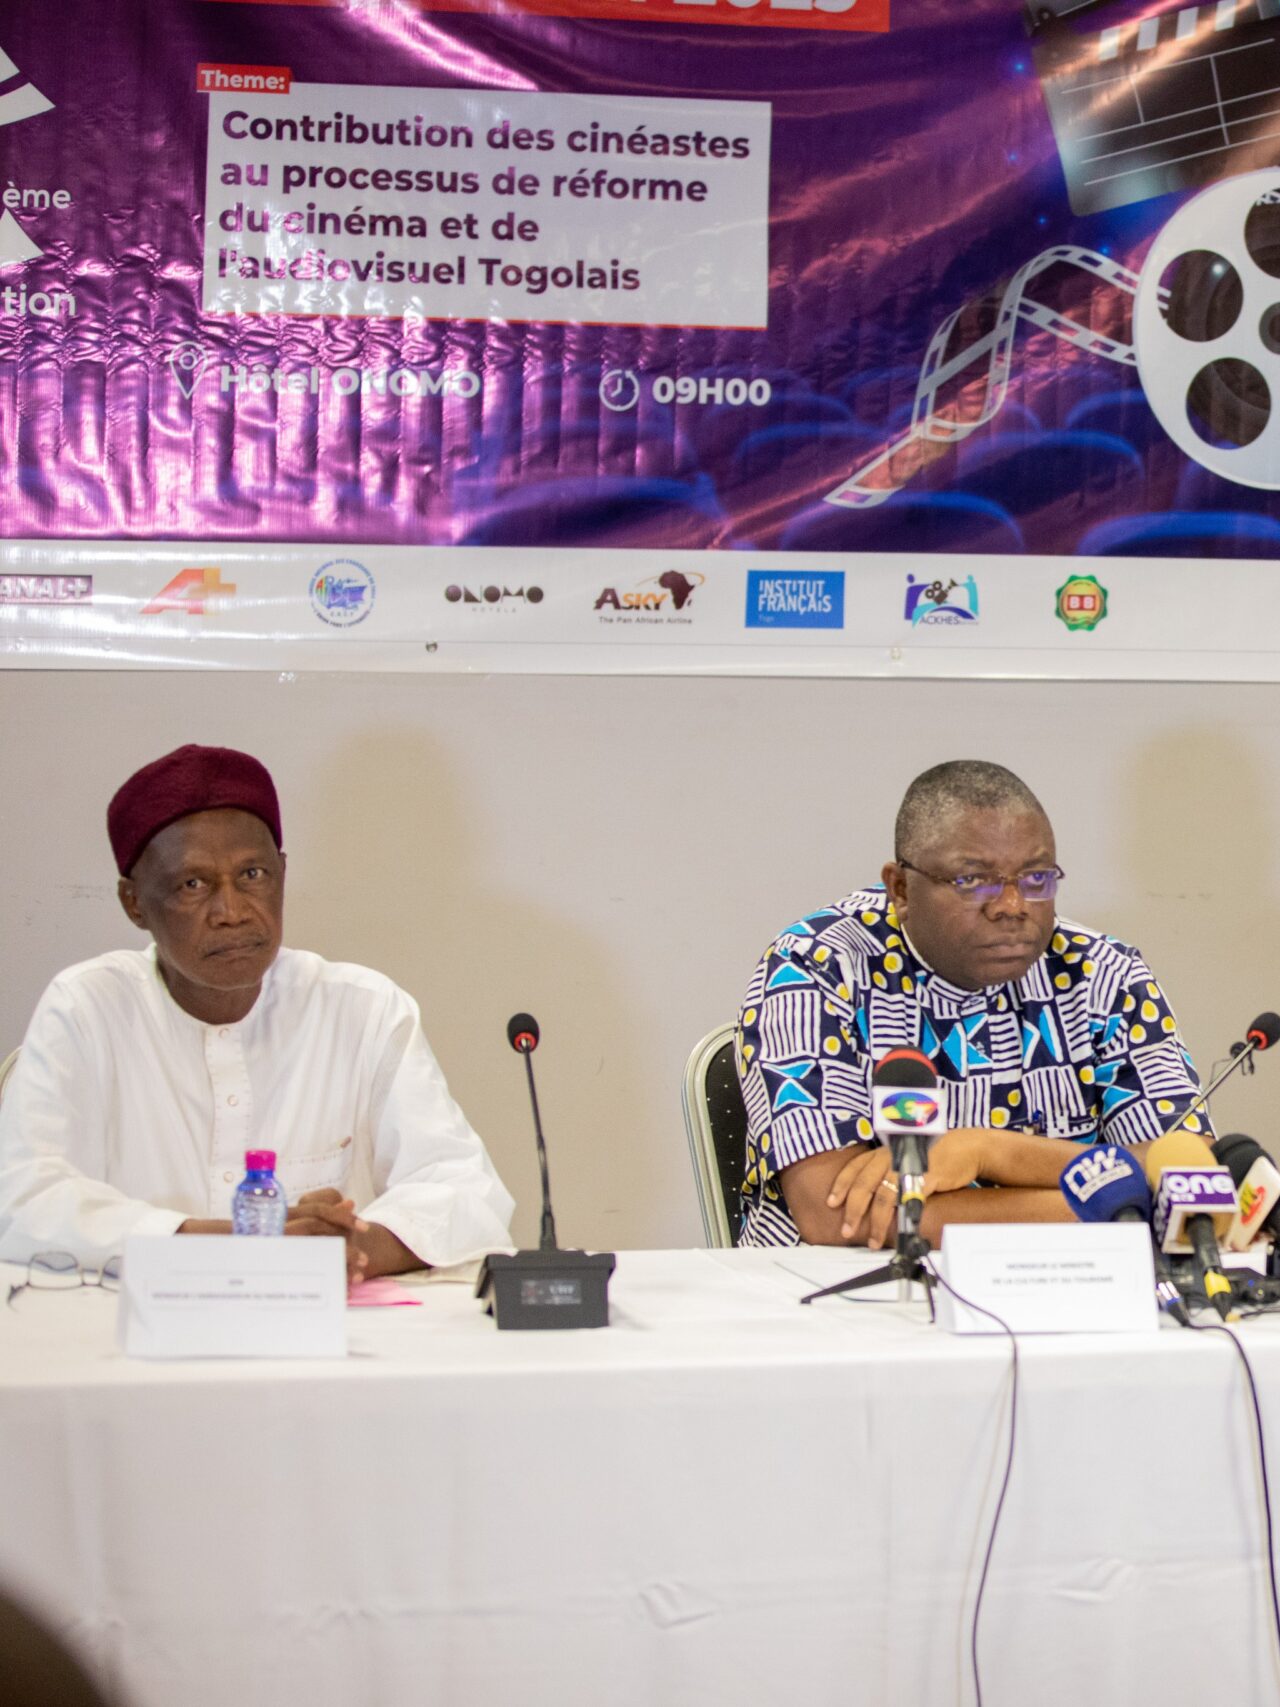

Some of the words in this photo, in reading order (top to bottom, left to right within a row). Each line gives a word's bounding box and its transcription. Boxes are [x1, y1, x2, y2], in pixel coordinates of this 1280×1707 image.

[200, 69, 285, 90] Theme:
[222, 110, 473, 148] Contribution
[486, 120, 554, 151] des
[566, 121, 750, 158] cinéastes
[220, 162, 269, 186] au
[282, 163, 480, 194] processus
[492, 166, 540, 196] de
[552, 168, 708, 202] réforme
[218, 201, 269, 232] du
[282, 201, 427, 238] cinéma
[440, 212, 479, 240] et
[491, 212, 539, 242] de
[217, 248, 466, 285] l'audiovisuel
[478, 257, 640, 294] Togolais
[0, 283, 76, 316] tion
[220, 363, 318, 395] Hôtel
[331, 367, 481, 398] ONOMO
[652, 375, 771, 406] 09H00
[0, 577, 88, 598] ANAL+
[593, 587, 668, 611] ASKY
[759, 579, 825, 598] INSTITUT
[758, 594, 832, 615] FRANÇAIS
[1166, 1174, 1234, 1195] one
